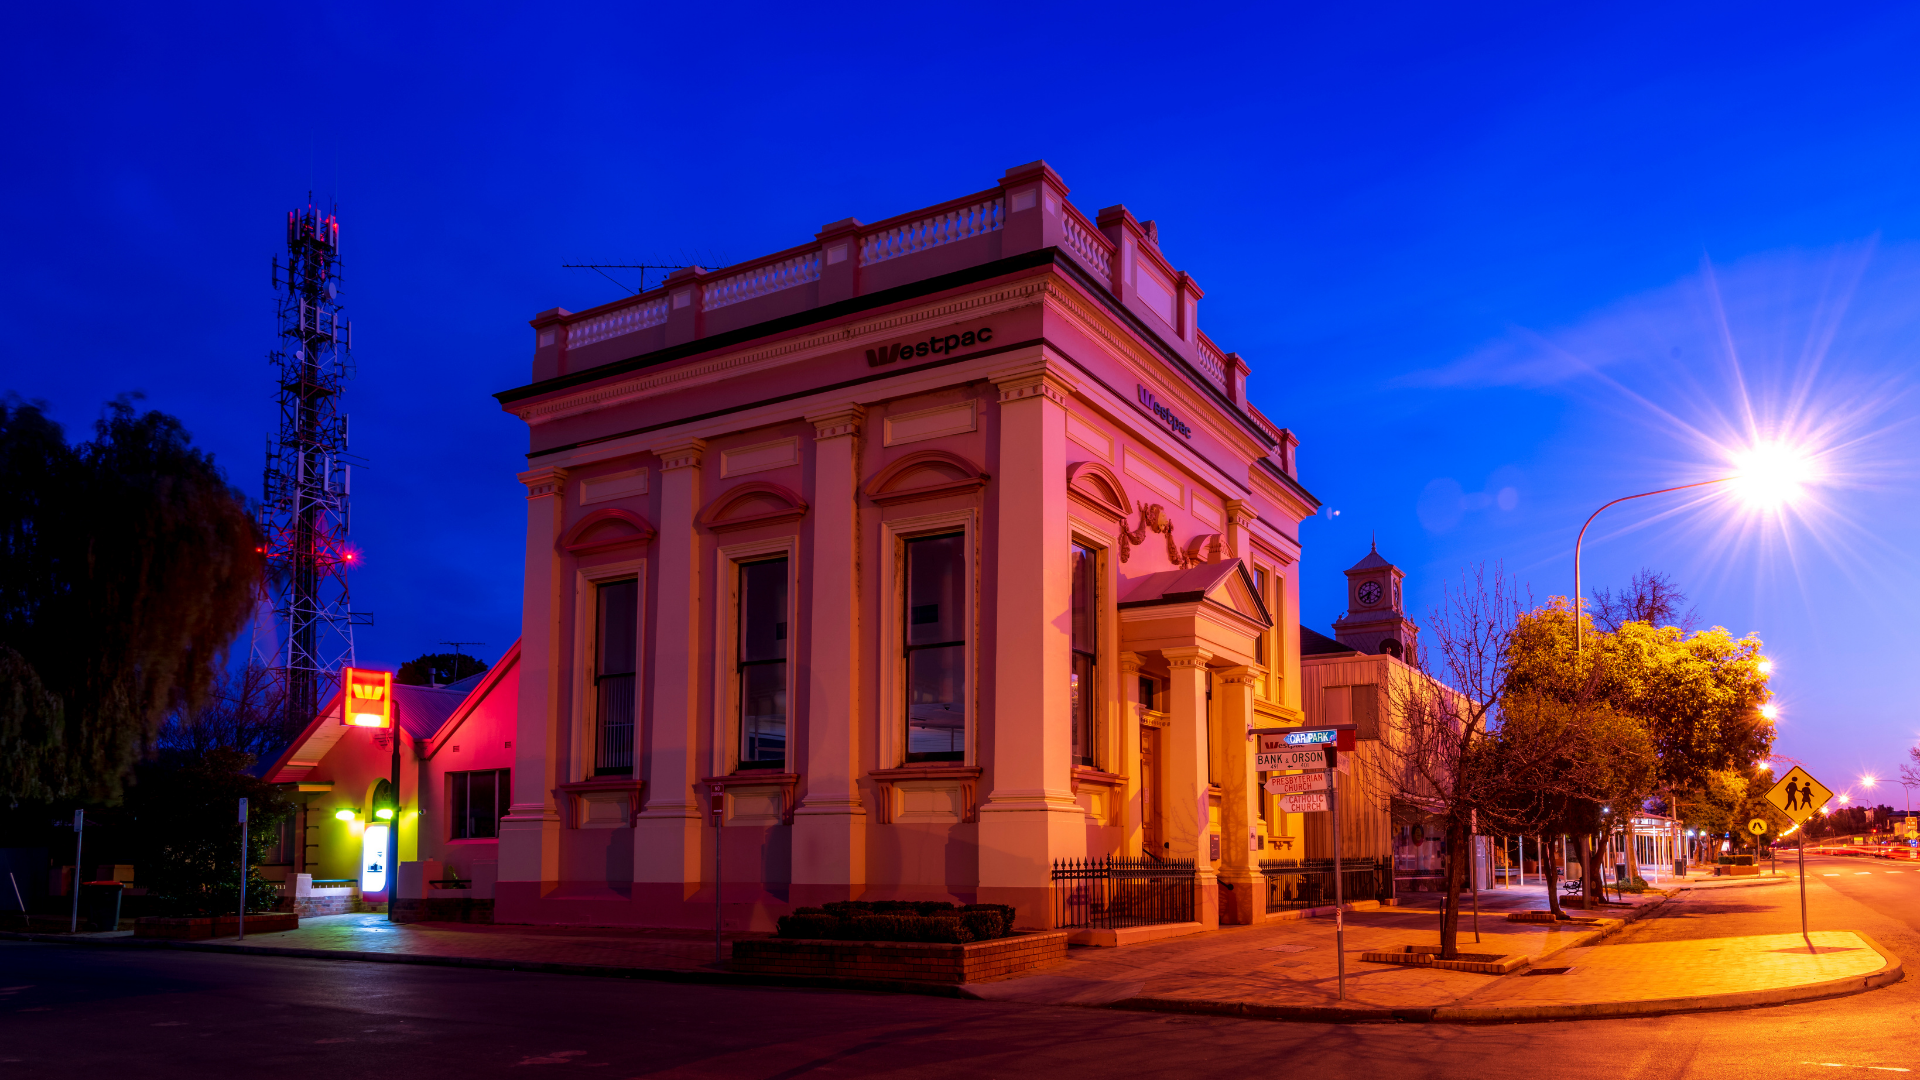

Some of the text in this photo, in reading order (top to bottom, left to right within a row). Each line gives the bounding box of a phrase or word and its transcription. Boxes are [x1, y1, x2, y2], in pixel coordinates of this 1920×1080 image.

[865, 327, 993, 368] Westpac
[1137, 383, 1192, 439] Westpac
[1289, 731, 1329, 744] CAR PARK
[1257, 754, 1283, 765] BANK
[1292, 751, 1323, 763] ORSON
[1271, 773, 1323, 786] PRESBYTERIAN
[1284, 782, 1312, 792] CHURCH
[1288, 794, 1324, 804] CATHOLIC
[1291, 802, 1321, 812] CHURCH
